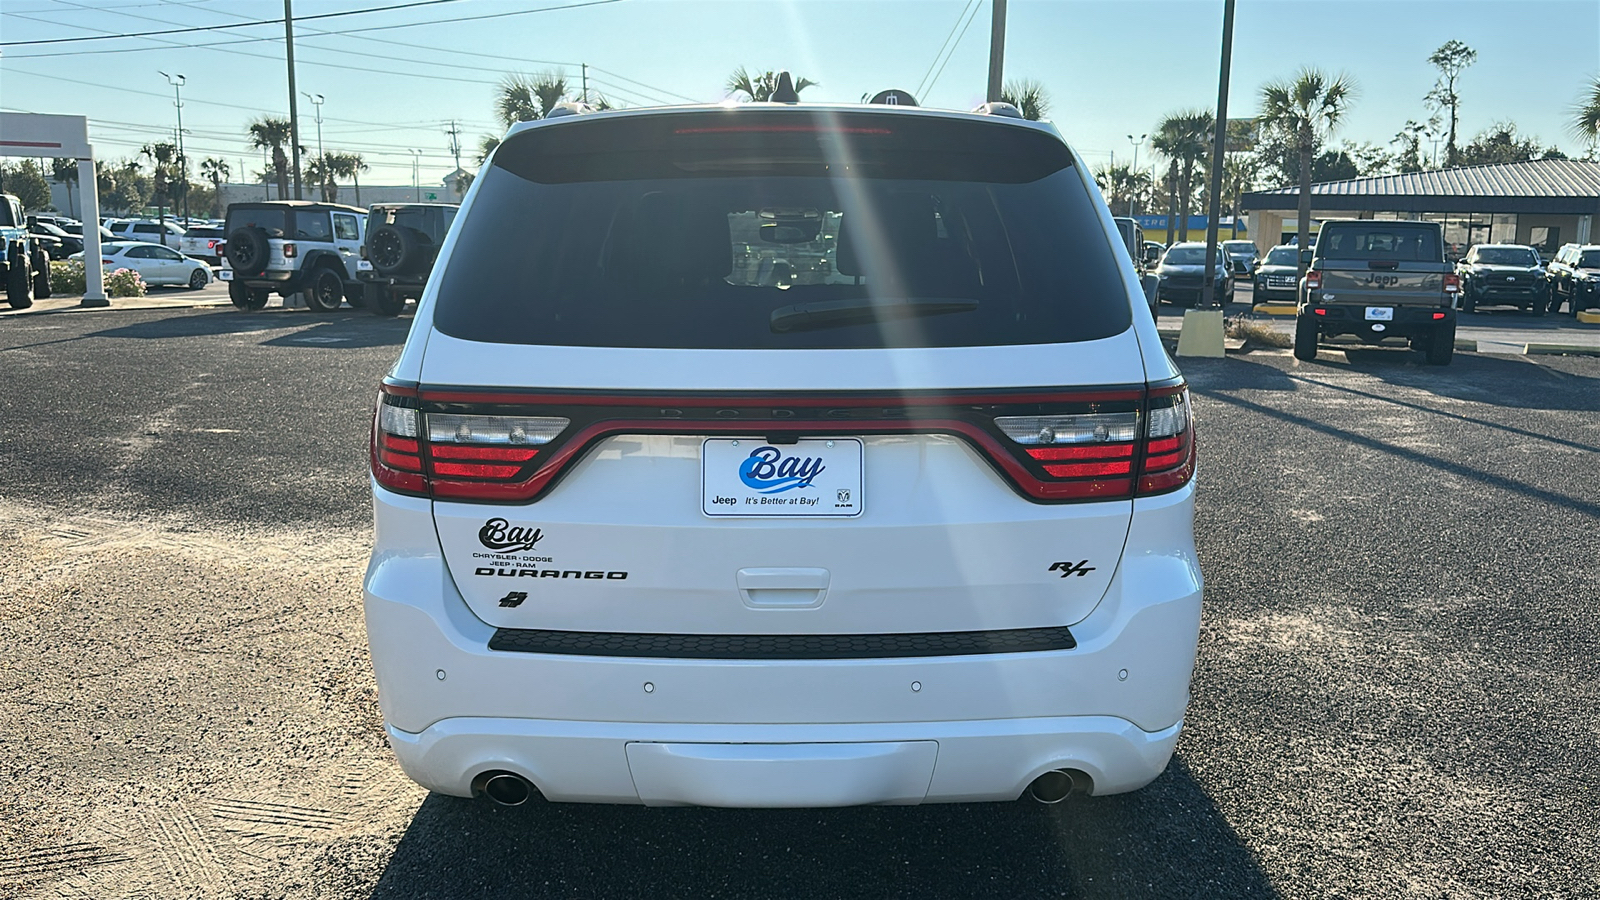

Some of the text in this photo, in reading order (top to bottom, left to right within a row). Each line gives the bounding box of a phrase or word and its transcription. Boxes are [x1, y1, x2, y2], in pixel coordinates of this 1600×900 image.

[1366, 273, 1398, 285] Jeep
[746, 446, 826, 488] Bay
[712, 495, 737, 506] Jeep
[745, 497, 820, 507] It's Better at Bay!
[485, 517, 544, 550] Bay
[472, 552, 517, 561] CHRYSLER
[475, 567, 629, 580] DURANGO
[1048, 559, 1096, 578] R/T
